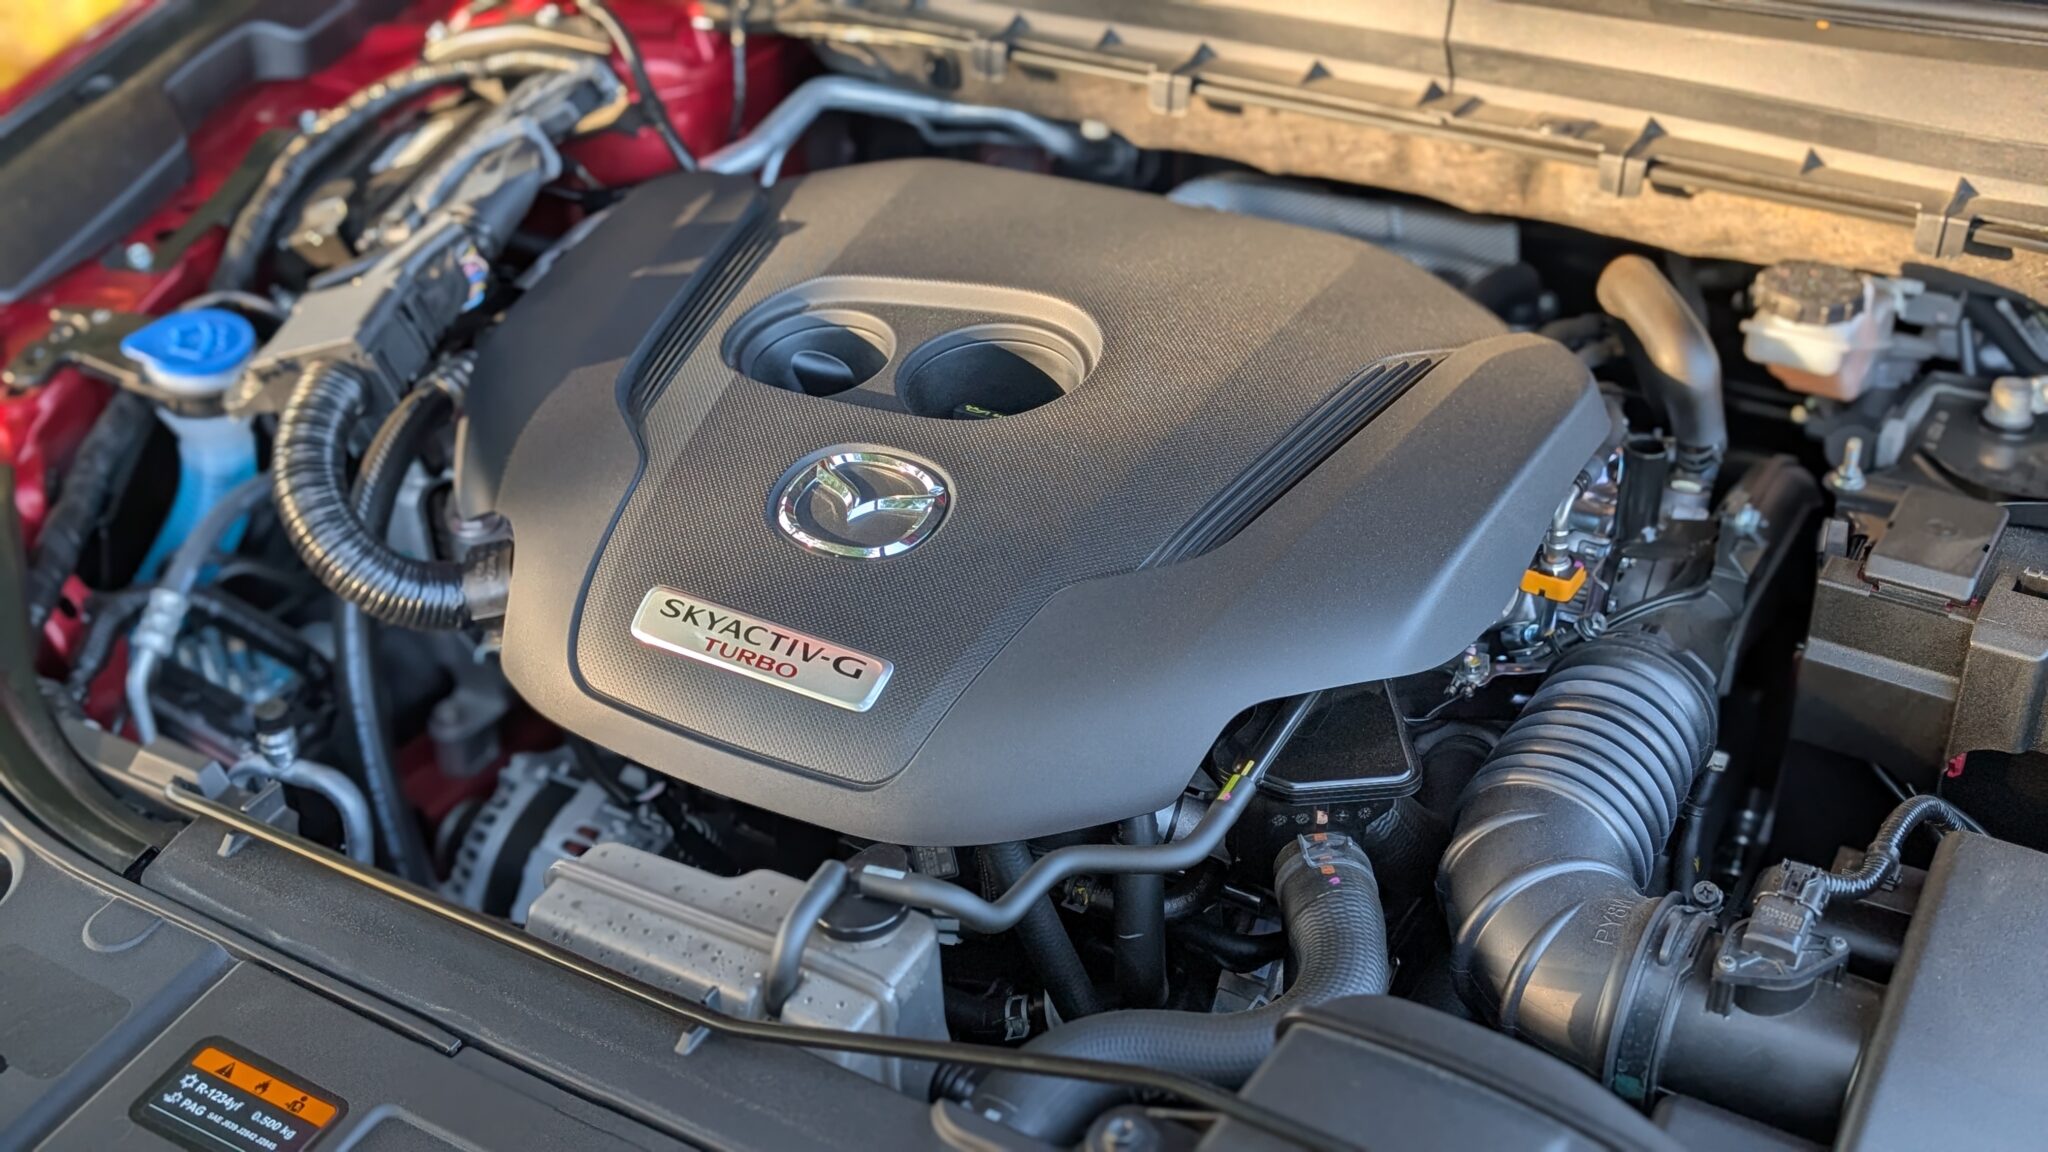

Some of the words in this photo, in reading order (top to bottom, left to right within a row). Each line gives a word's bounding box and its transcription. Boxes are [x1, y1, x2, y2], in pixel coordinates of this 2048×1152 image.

[660, 599, 867, 680] SKYACTIV-G
[705, 637, 798, 678] TURBO
[180, 1098, 207, 1117] PAG
[206, 1112, 225, 1124] SAE
[195, 1082, 245, 1112] R-1234yf
[251, 1110, 283, 1131] 0.500
[280, 1125, 297, 1141] kg
